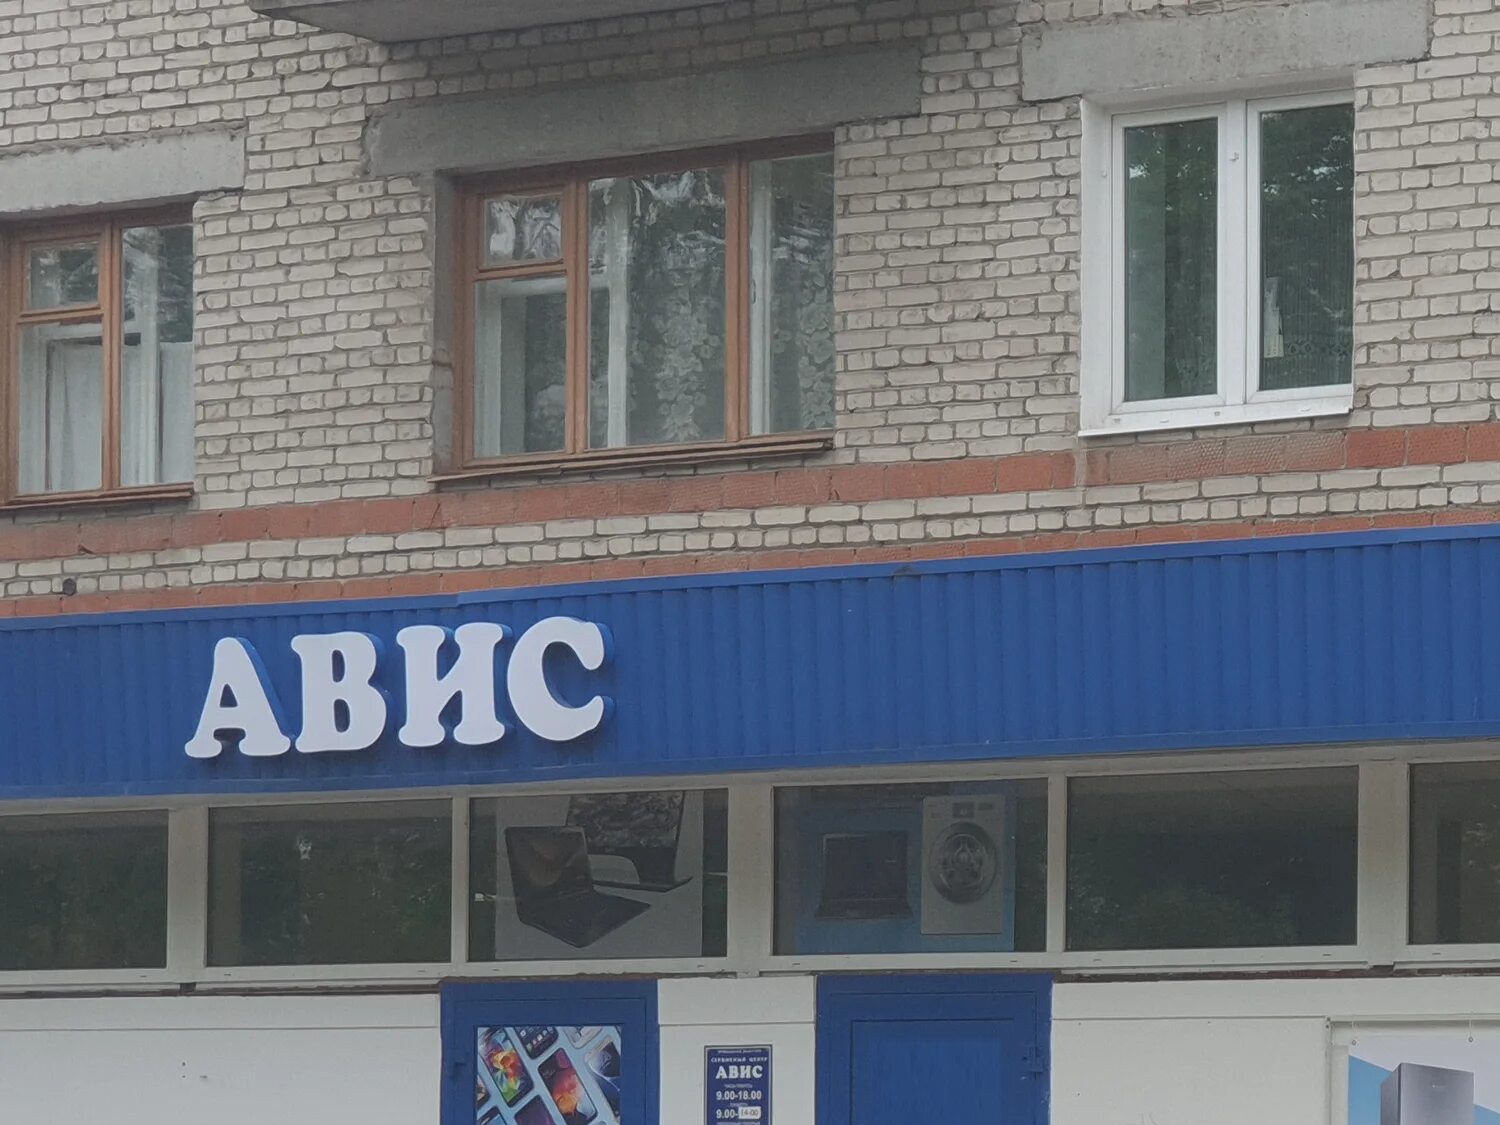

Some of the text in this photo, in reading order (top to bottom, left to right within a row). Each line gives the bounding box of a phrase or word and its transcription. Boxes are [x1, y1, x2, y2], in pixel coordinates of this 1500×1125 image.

[184, 616, 606, 759] АВИС
[715, 1065, 763, 1079] АВИС
[716, 1090, 762, 1100] 9.00-18.00
